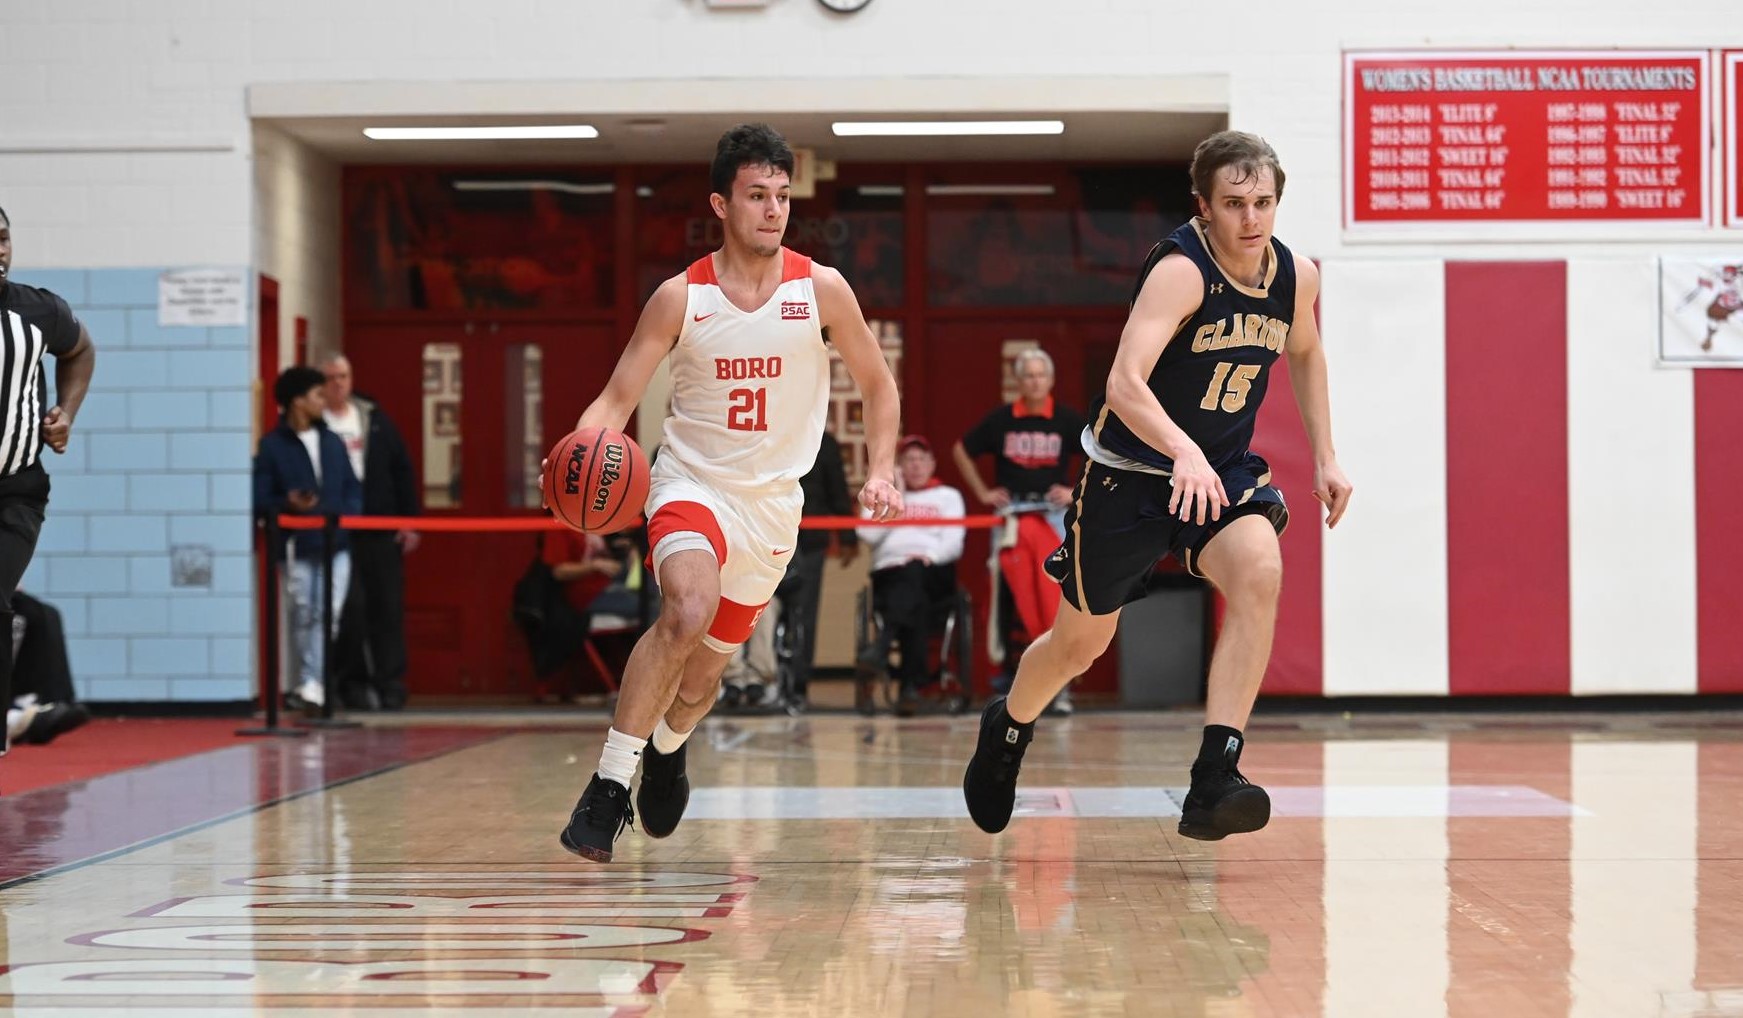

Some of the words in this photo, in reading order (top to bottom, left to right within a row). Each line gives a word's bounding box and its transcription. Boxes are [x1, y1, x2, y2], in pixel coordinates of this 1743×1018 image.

[1434, 67, 1535, 91] BASKETBALL
[1537, 66, 1580, 90] NCAA
[1581, 66, 1696, 90] TOURNAMENTS
[781, 306, 810, 315] PSAC
[1191, 313, 1290, 354] CLARION
[715, 356, 782, 380] BORO
[1200, 362, 1261, 413] 15
[728, 387, 768, 431] 21
[565, 443, 588, 494] NCAA
[591, 442, 623, 512] Wilson
